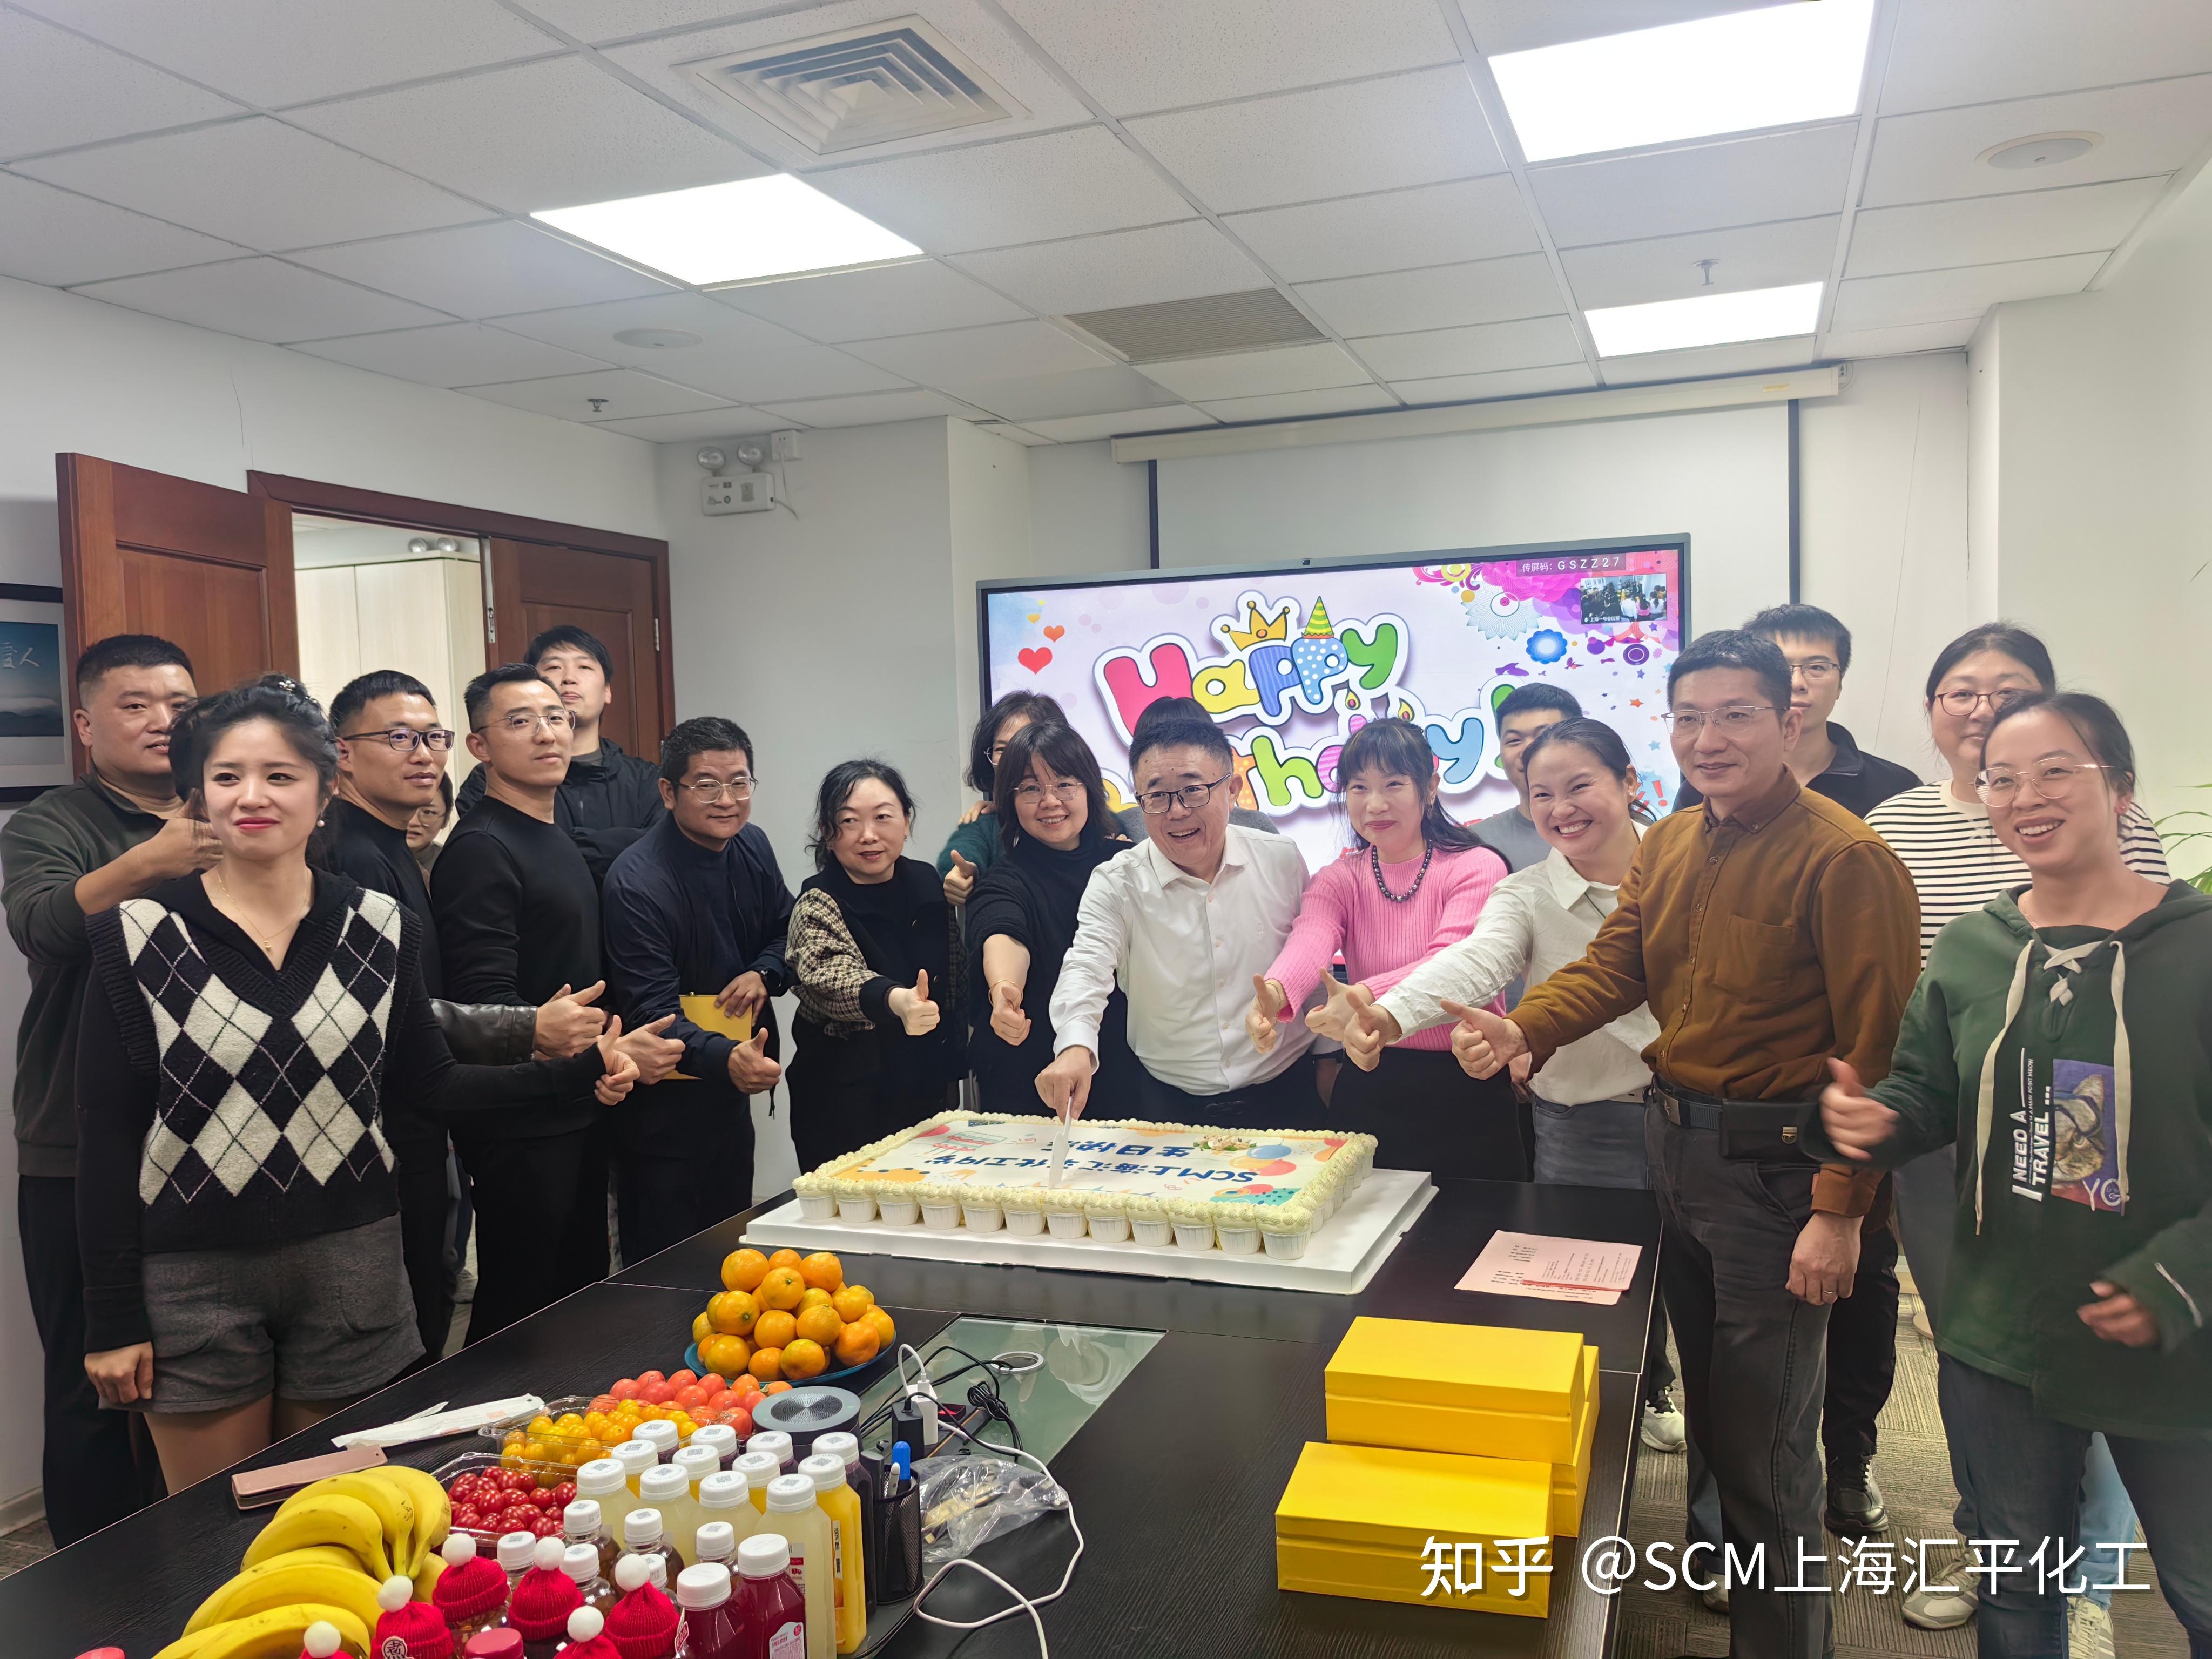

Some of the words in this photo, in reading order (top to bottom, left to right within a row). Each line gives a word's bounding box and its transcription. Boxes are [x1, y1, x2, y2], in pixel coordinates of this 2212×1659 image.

[1557, 557, 1620, 570] GSZZ27
[1103, 623, 1399, 738] Happy
[2009, 1110, 2027, 1124] A
[2013, 1129, 2027, 1183] NEED
[2032, 1111, 2050, 1186] TRAVEL
